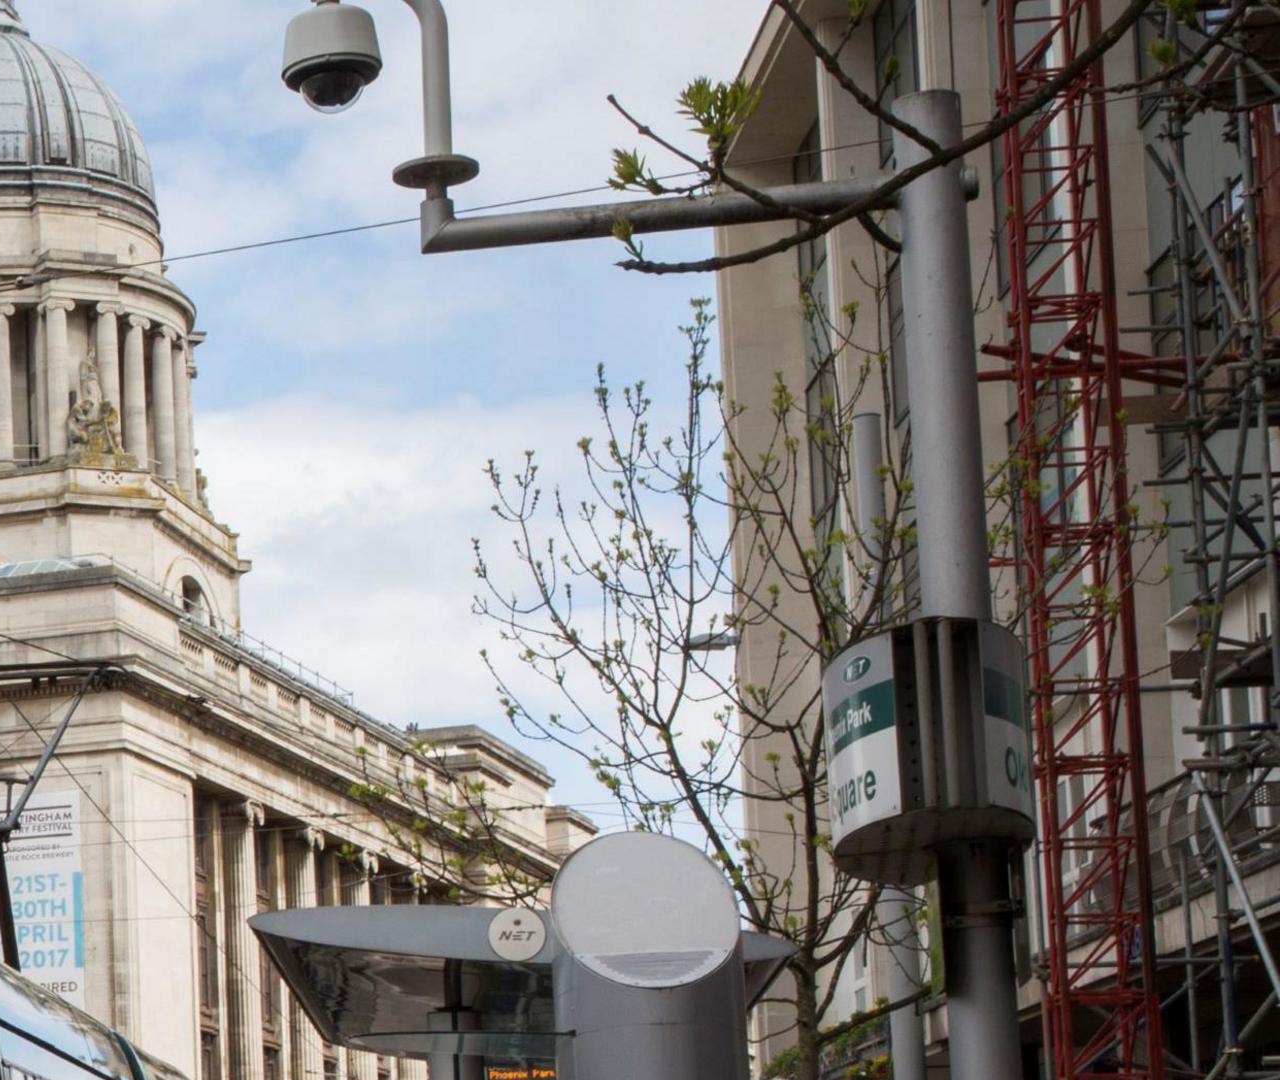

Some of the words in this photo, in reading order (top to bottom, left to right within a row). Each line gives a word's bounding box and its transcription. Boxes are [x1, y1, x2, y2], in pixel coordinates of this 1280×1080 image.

[847, 702, 872, 733] Park
[32, 822, 72, 833] FESTIVAL
[13, 873, 66, 894] 21ST-
[13, 898, 66, 919] 30TH
[17, 924, 69, 943] PRIL
[498, 930, 536, 942] NET
[19, 948, 69, 969] 2017
